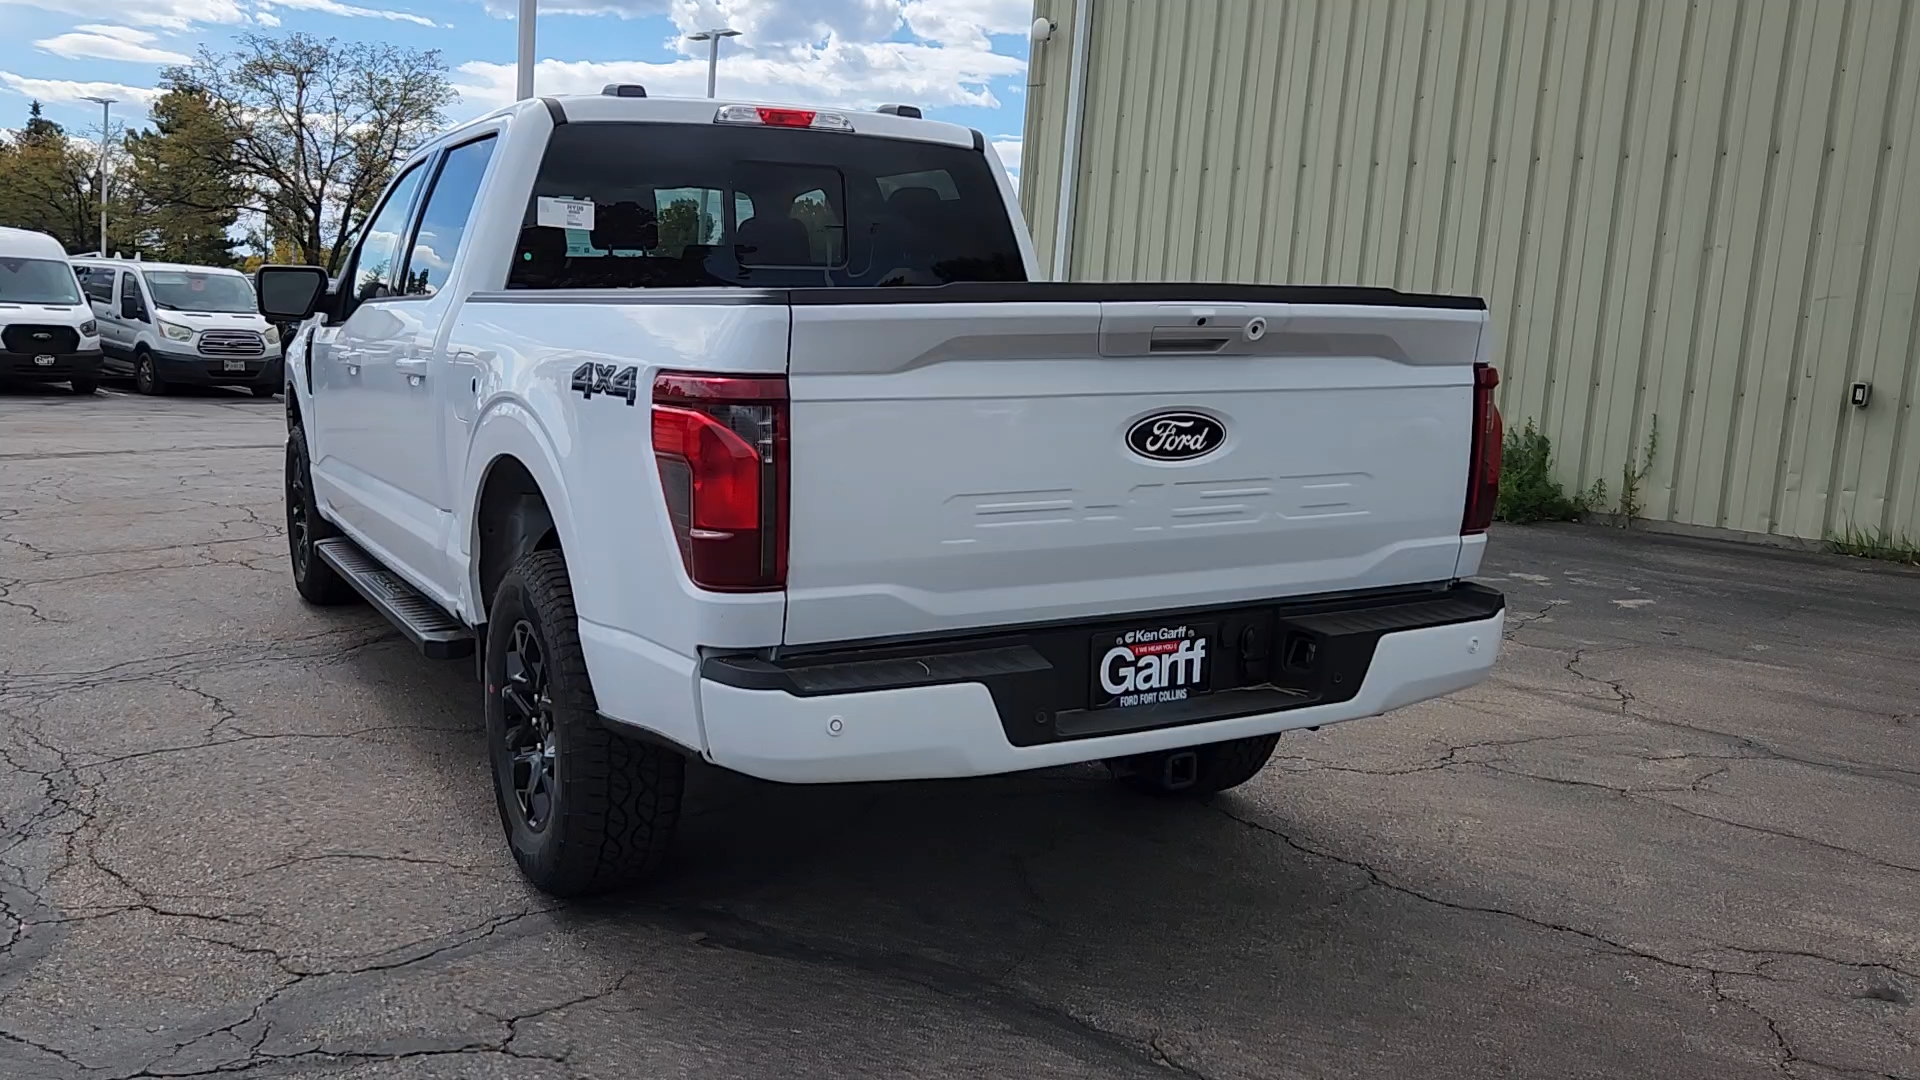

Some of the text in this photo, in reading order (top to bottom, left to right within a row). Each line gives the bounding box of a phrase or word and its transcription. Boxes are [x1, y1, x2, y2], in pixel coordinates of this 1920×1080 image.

[1145, 419, 1210, 452] Ford
[1135, 625, 1187, 642] Ken Garff
[1148, 644, 1163, 652] HEAR
[1100, 637, 1206, 695] Garff
[1120, 688, 1188, 708] FORD FORT COLLINS
